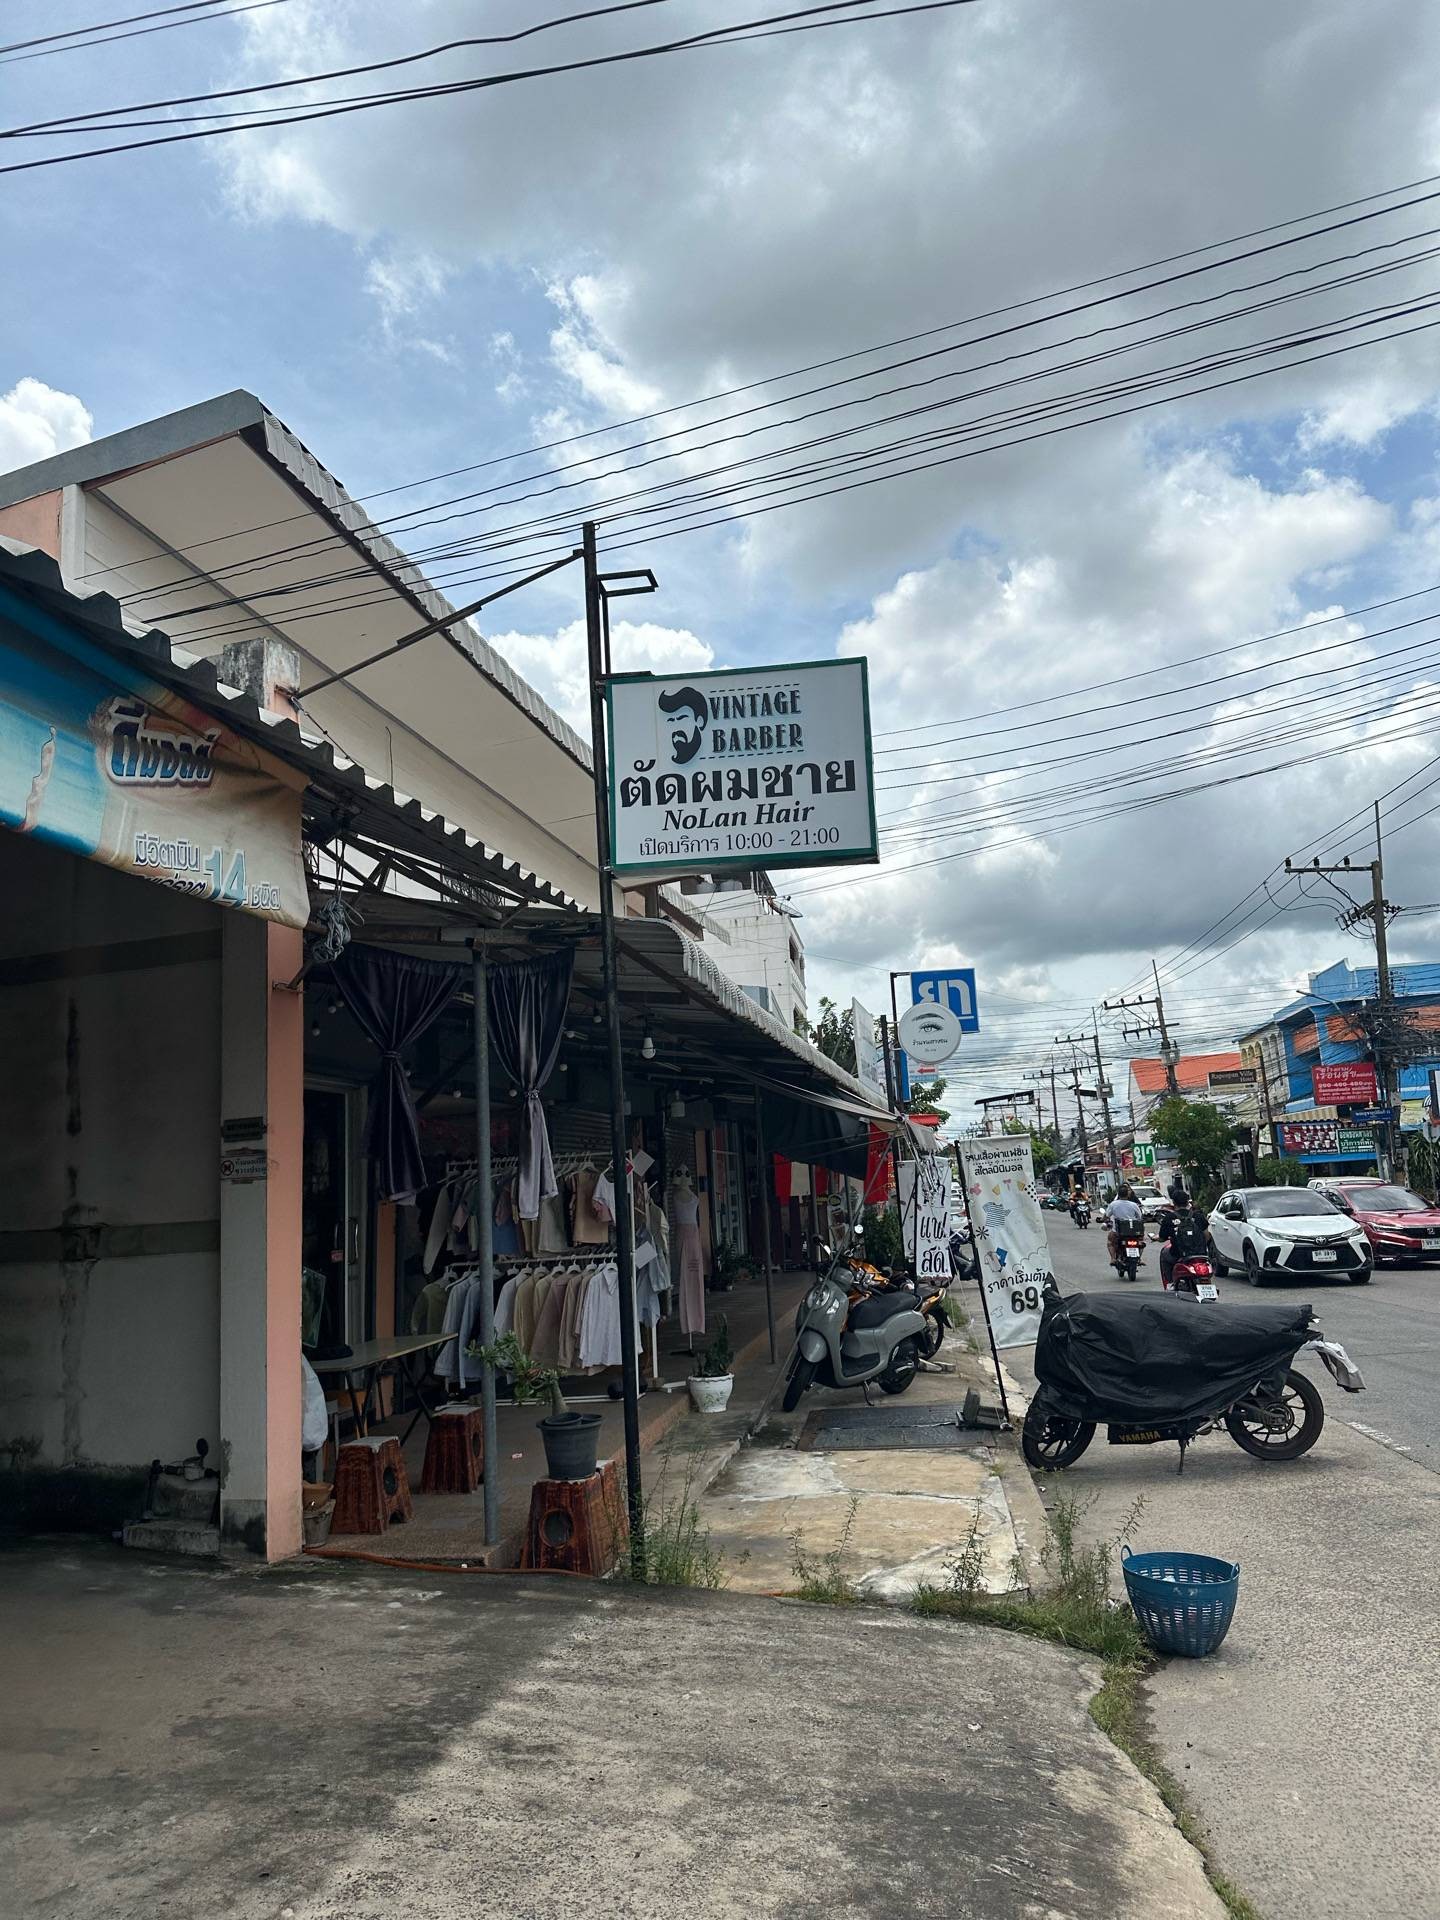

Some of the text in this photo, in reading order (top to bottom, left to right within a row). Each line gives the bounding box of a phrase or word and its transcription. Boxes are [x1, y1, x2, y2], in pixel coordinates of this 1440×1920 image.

[708, 689, 802, 720] VINTAGE
[712, 722, 804, 754] BARBER
[619, 758, 857, 808] ตัดผมชาย
[662, 801, 815, 831] NoLan Hair
[639, 836, 719, 856] เปิดบริการ
[726, 831, 773, 851] 10:00
[790, 827, 840, 847] 21:00
[134, 833, 281, 911] มีวิตามิน 14 ชนิด
[964, 1145, 1029, 1162] ร้านเสื้อผ้าแฟชั่น
[1133, 1145, 1156, 1165] ยา
[1119, 1430, 1161, 1441] YAMAHA
